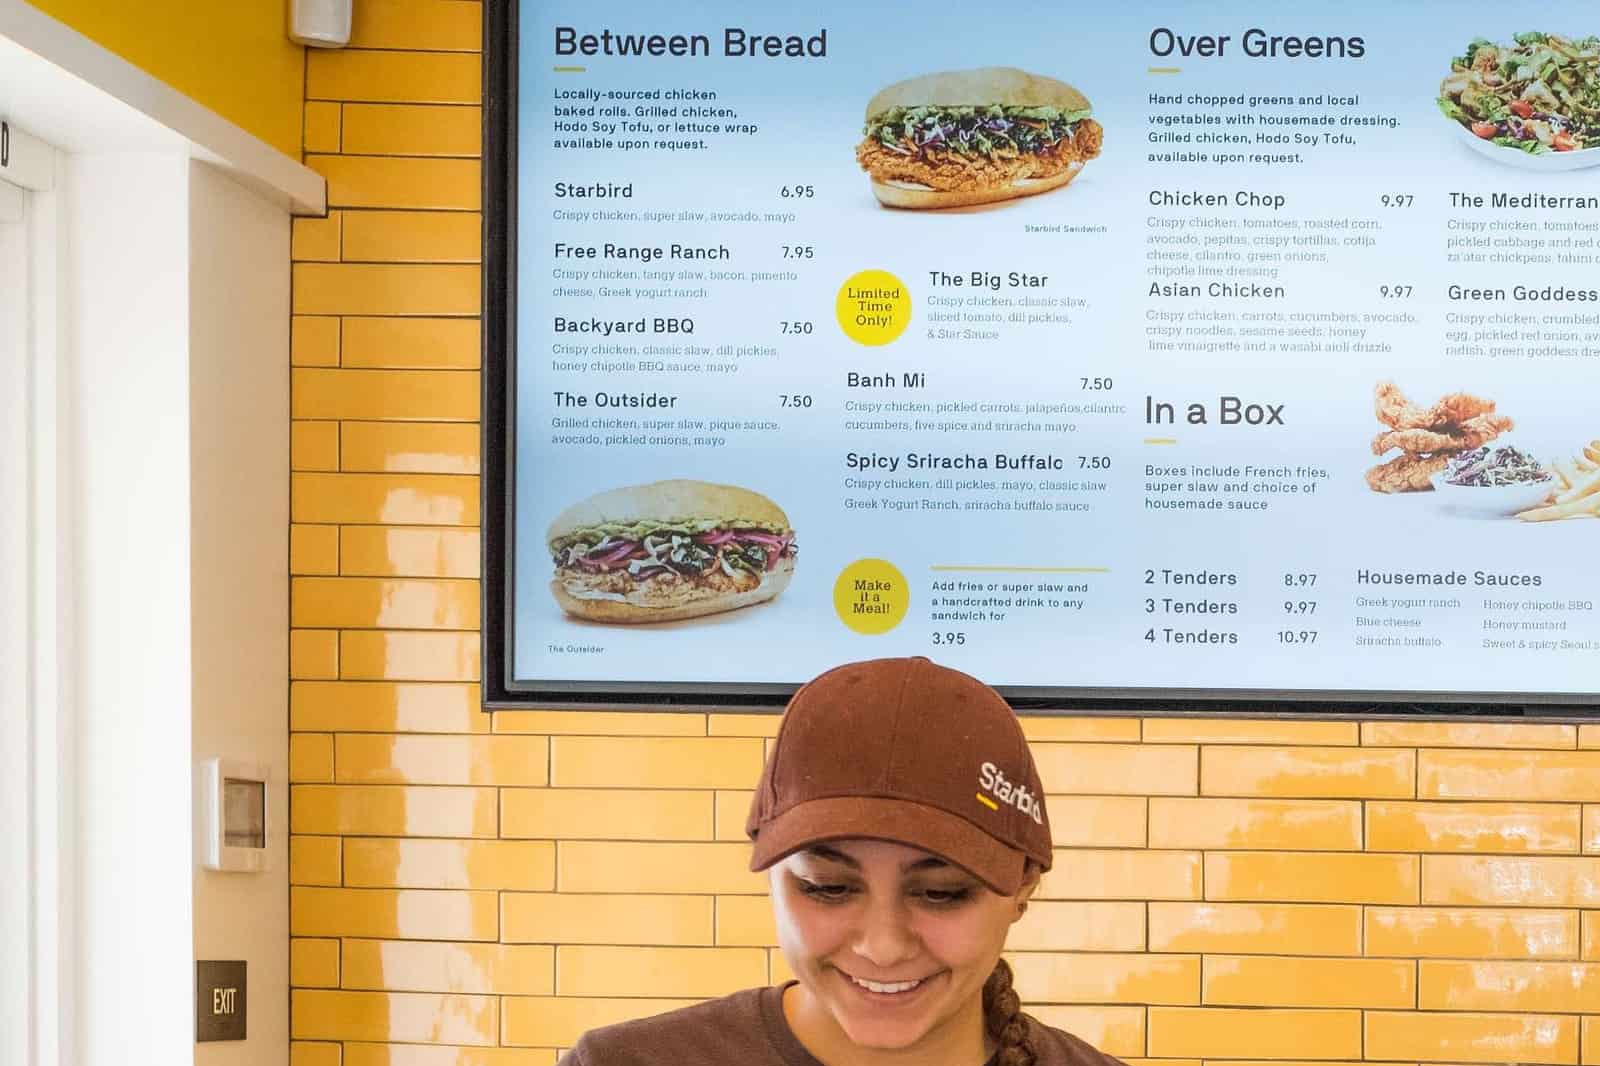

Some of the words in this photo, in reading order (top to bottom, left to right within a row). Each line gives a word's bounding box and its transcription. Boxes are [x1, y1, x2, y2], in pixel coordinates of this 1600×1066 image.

[555, 27, 709, 56] Between
[724, 28, 827, 58] Bread
[1150, 28, 1231, 57] Over
[1242, 28, 1365, 58] Greens
[554, 88, 660, 102] Locally-sourced
[664, 88, 716, 100] chicken
[554, 182, 632, 198] Starbird
[781, 185, 814, 198] 6.95
[1149, 190, 1228, 206] Chicken
[1235, 191, 1285, 210] Chop
[1381, 194, 1414, 207] 9.97
[1449, 192, 1484, 208] The
[555, 243, 596, 258] Free
[604, 243, 663, 263] Range
[671, 244, 729, 260] Ranch
[782, 246, 814, 259] 7.95
[929, 271, 963, 286] The
[971, 272, 1001, 291] Big
[1008, 272, 1048, 287] Star
[848, 287, 900, 299] Limited
[1148, 282, 1201, 297] Asian
[1208, 282, 1284, 298] Chicken
[1380, 285, 1413, 298] 9.97
[1448, 285, 1505, 301] Green
[1513, 286, 1598, 302] Goddess
[858, 300, 892, 312] Time
[554, 317, 646, 336] Backyard
[654, 318, 694, 334] BBQ
[780, 322, 813, 334] 7.50
[856, 314, 892, 328] Only!
[848, 372, 895, 388] Banh
[903, 373, 925, 388] Mi
[1080, 378, 1113, 390] 7.50
[553, 392, 588, 407] The
[595, 392, 678, 408] Outsider
[780, 395, 812, 408] 7.50
[1146, 396, 1174, 424] In
[1187, 403, 1208, 424] a
[1220, 396, 1284, 425] Box
[846, 452, 900, 472] Spicy
[907, 453, 988, 469] Sriracha
[1078, 456, 1111, 469] 7.50
[854, 580, 891, 591] Make
[1144, 569, 1154, 584] 2
[1162, 569, 1237, 585] Tenders
[1284, 574, 1317, 586] 8.97
[1358, 569, 1467, 585] Housemade
[1474, 571, 1542, 586] Sauces
[853, 602, 890, 614] Meal!
[1144, 628, 1156, 643] 4
[1162, 628, 1238, 644] Tenders
[1277, 630, 1318, 643] 10.97
[213, 987, 237, 1014] EXIT
